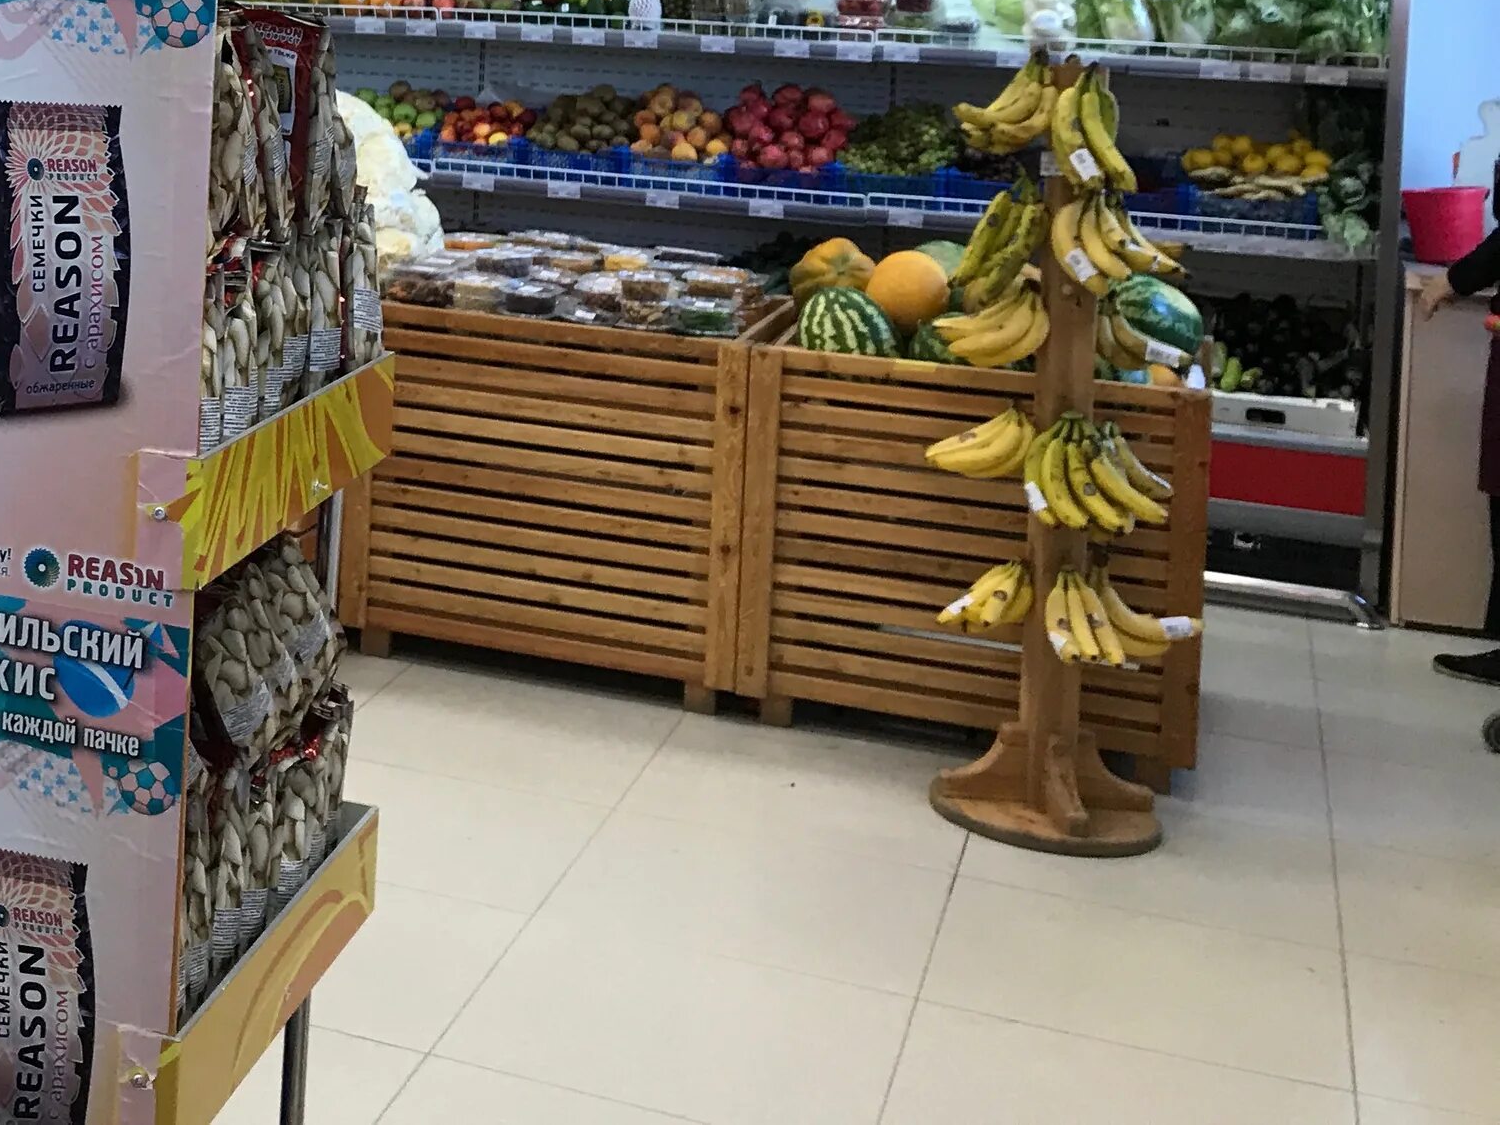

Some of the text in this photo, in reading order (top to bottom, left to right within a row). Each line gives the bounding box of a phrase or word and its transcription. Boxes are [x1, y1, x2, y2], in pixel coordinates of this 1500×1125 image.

[46, 158, 98, 173] REASON
[32, 195, 45, 293] СЕМЕЧКИ
[50, 194, 83, 374] REASON
[89, 236, 106, 353] арахисом
[26, 379, 96, 394] обжаренные
[66, 579, 174, 608] PRODUCT
[2, 713, 77, 745] каждой
[84, 726, 139, 757] пачке
[13, 908, 63, 927] REASON
[14, 944, 48, 1120] REASON
